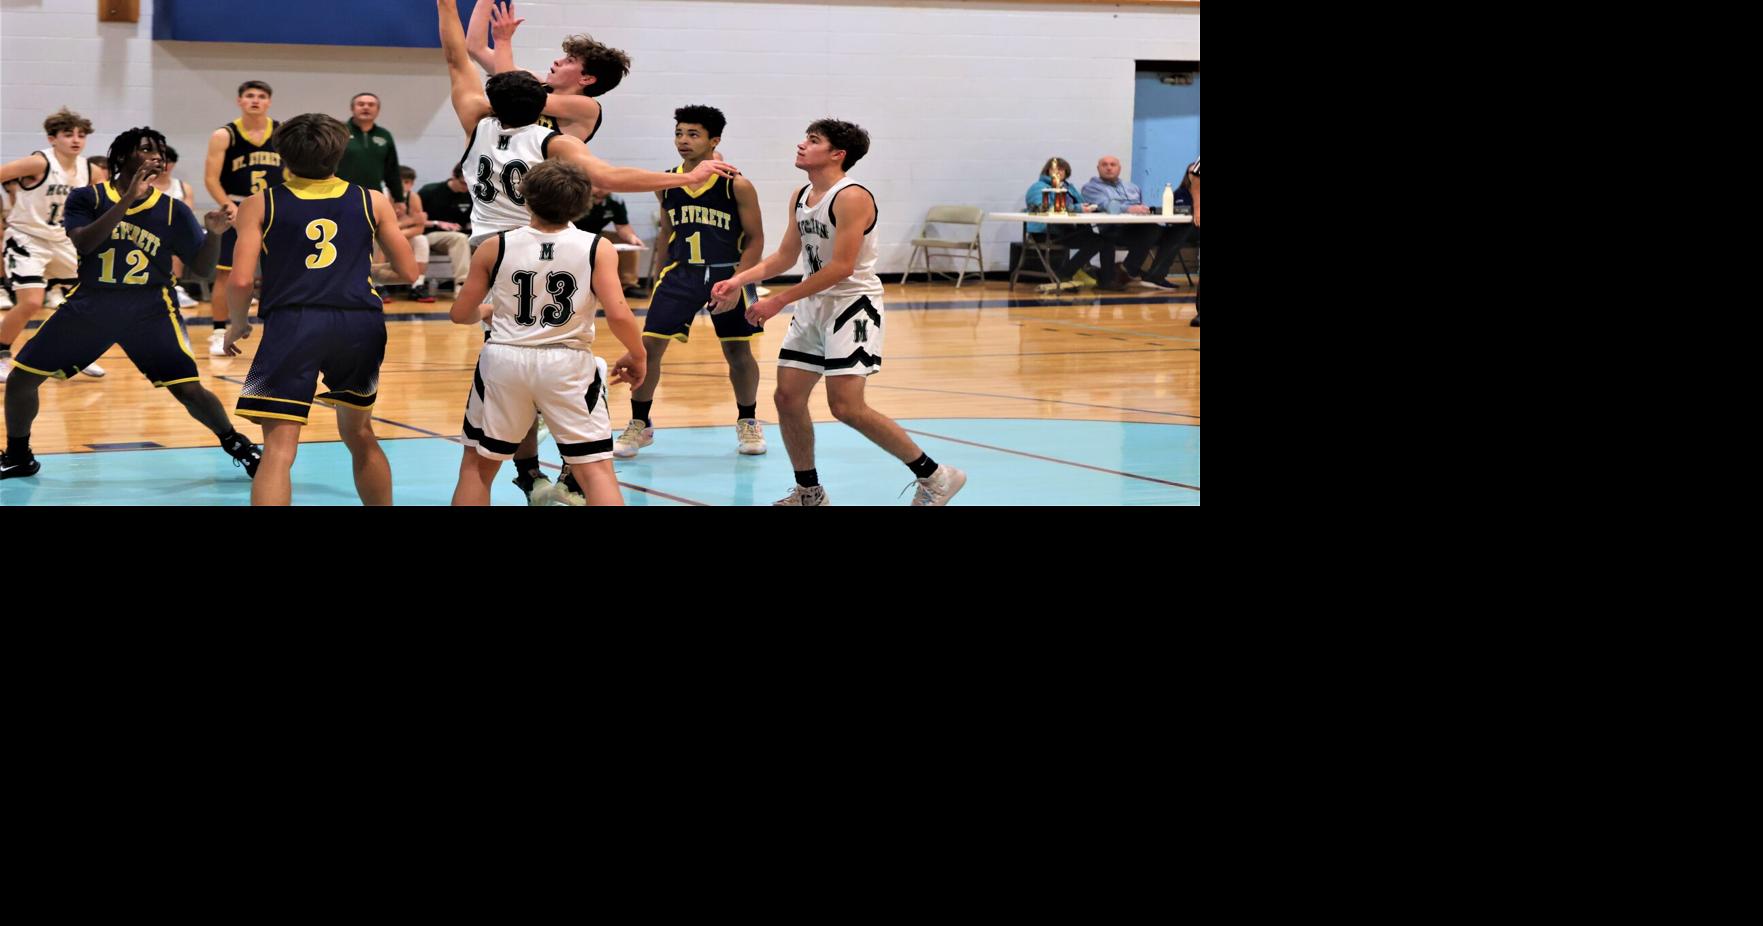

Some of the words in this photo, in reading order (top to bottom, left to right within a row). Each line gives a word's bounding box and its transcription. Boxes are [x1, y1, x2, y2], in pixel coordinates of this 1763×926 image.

[251, 170, 267, 194] 5
[473, 154, 530, 206] 30
[681, 205, 731, 231] EVERETT
[111, 220, 161, 256] EVERETT
[305, 218, 338, 269] 3
[539, 243, 555, 260] M
[685, 231, 705, 264] 1
[98, 248, 149, 284] 12
[512, 270, 578, 328] 13
[853, 319, 868, 342] M
